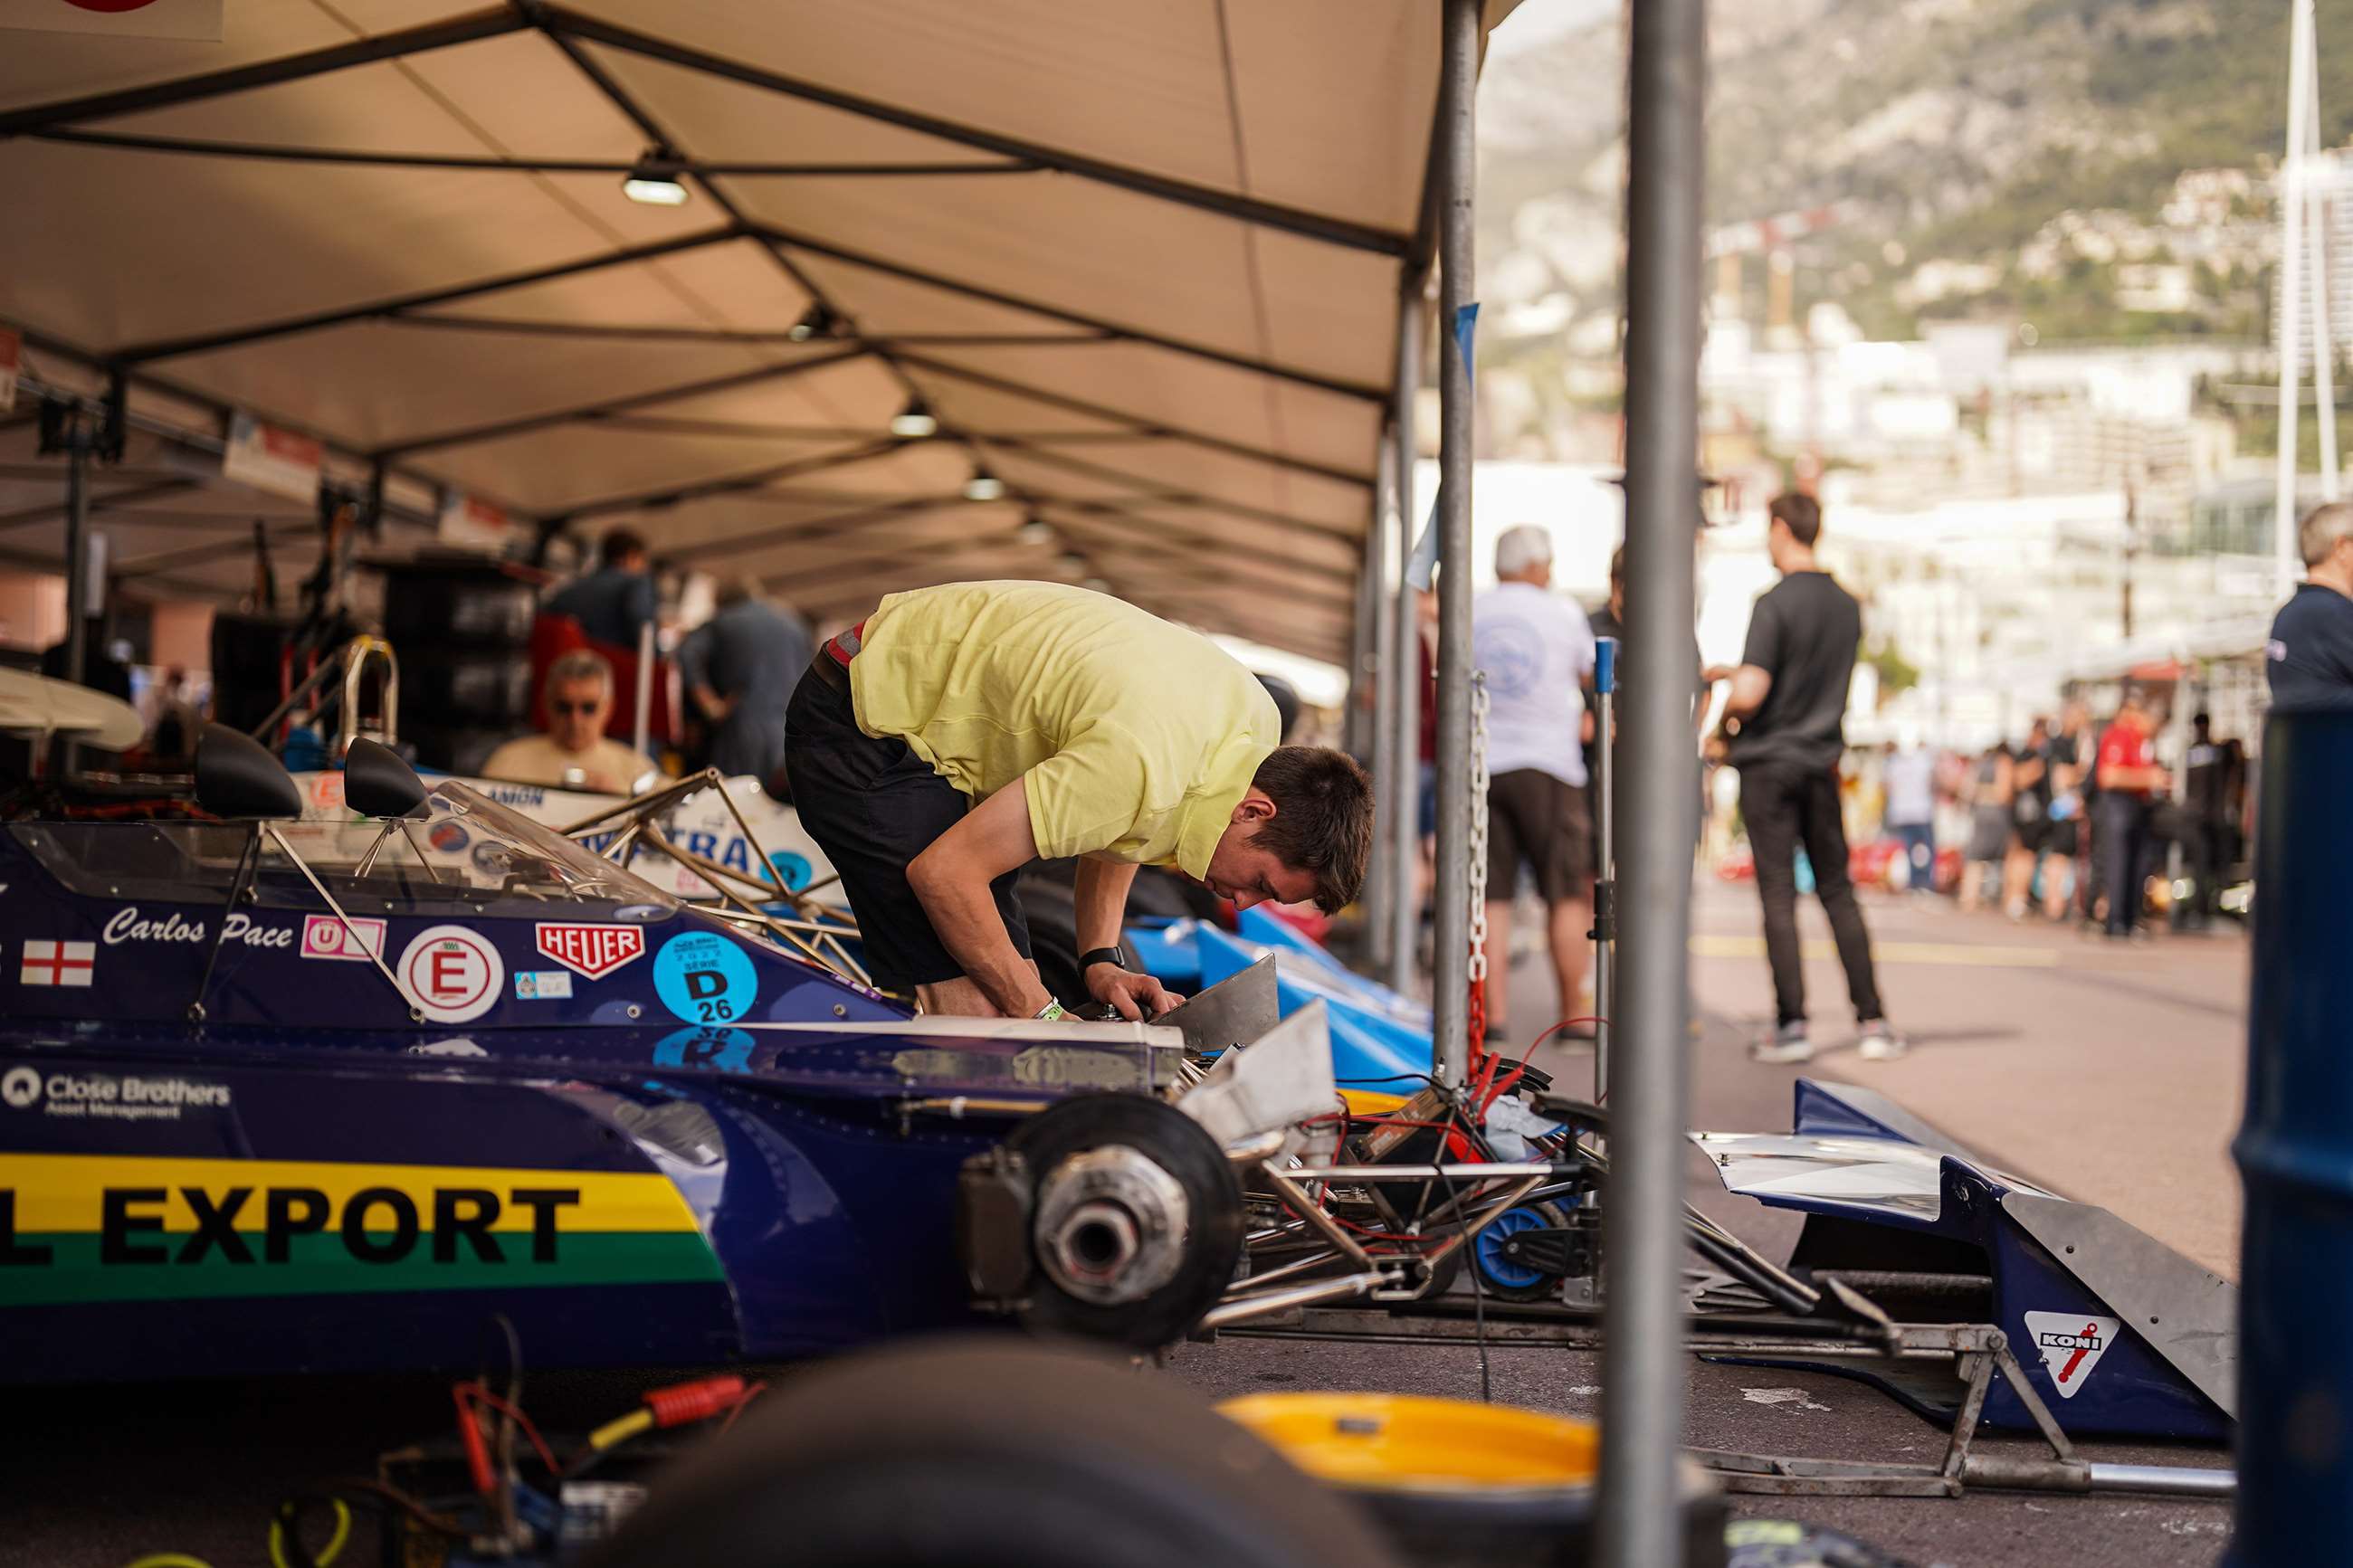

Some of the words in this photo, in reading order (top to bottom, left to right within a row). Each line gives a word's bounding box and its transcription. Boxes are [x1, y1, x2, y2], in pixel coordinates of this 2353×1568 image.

[102, 907, 205, 945] Carlos
[218, 913, 293, 947] Pace
[545, 928, 637, 970] HEUER
[432, 951, 468, 996] E
[683, 970, 729, 1001] D
[698, 999, 734, 1023] 26
[46, 1073, 118, 1101] Close
[121, 1078, 231, 1106] Brothers
[101, 1186, 580, 1265] EXPORT
[2042, 1334, 2100, 1350] KONI
